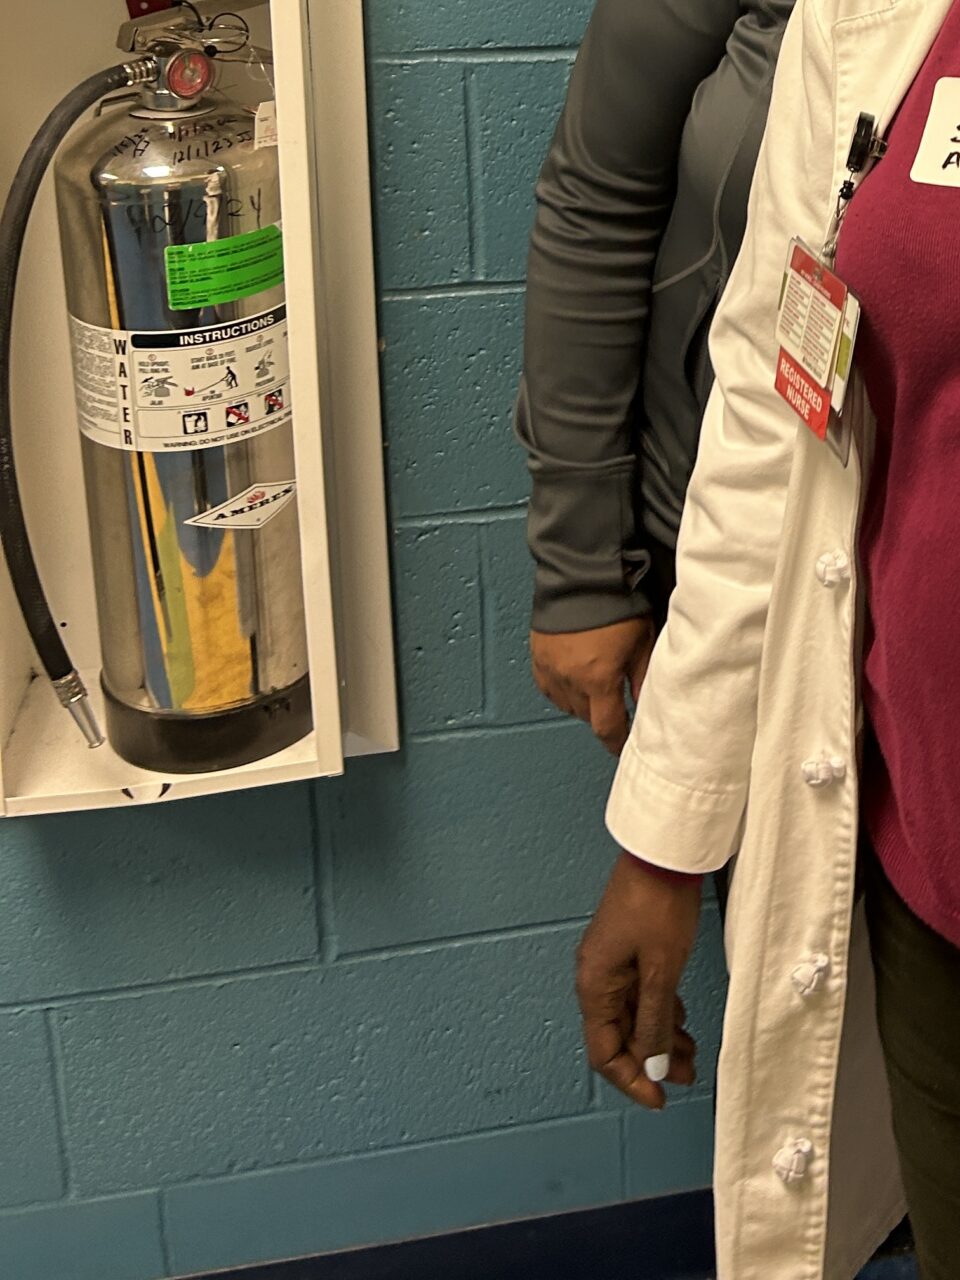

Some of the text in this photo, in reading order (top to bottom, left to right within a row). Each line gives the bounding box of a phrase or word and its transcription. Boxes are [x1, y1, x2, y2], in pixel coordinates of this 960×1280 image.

[179, 314, 275, 346] INSTRUCTIONS
[113, 338, 133, 446] WATER
[779, 357, 823, 412] REGISTERED
[786, 386, 811, 420] NURSE
[213, 484, 294, 521] AMEREX
